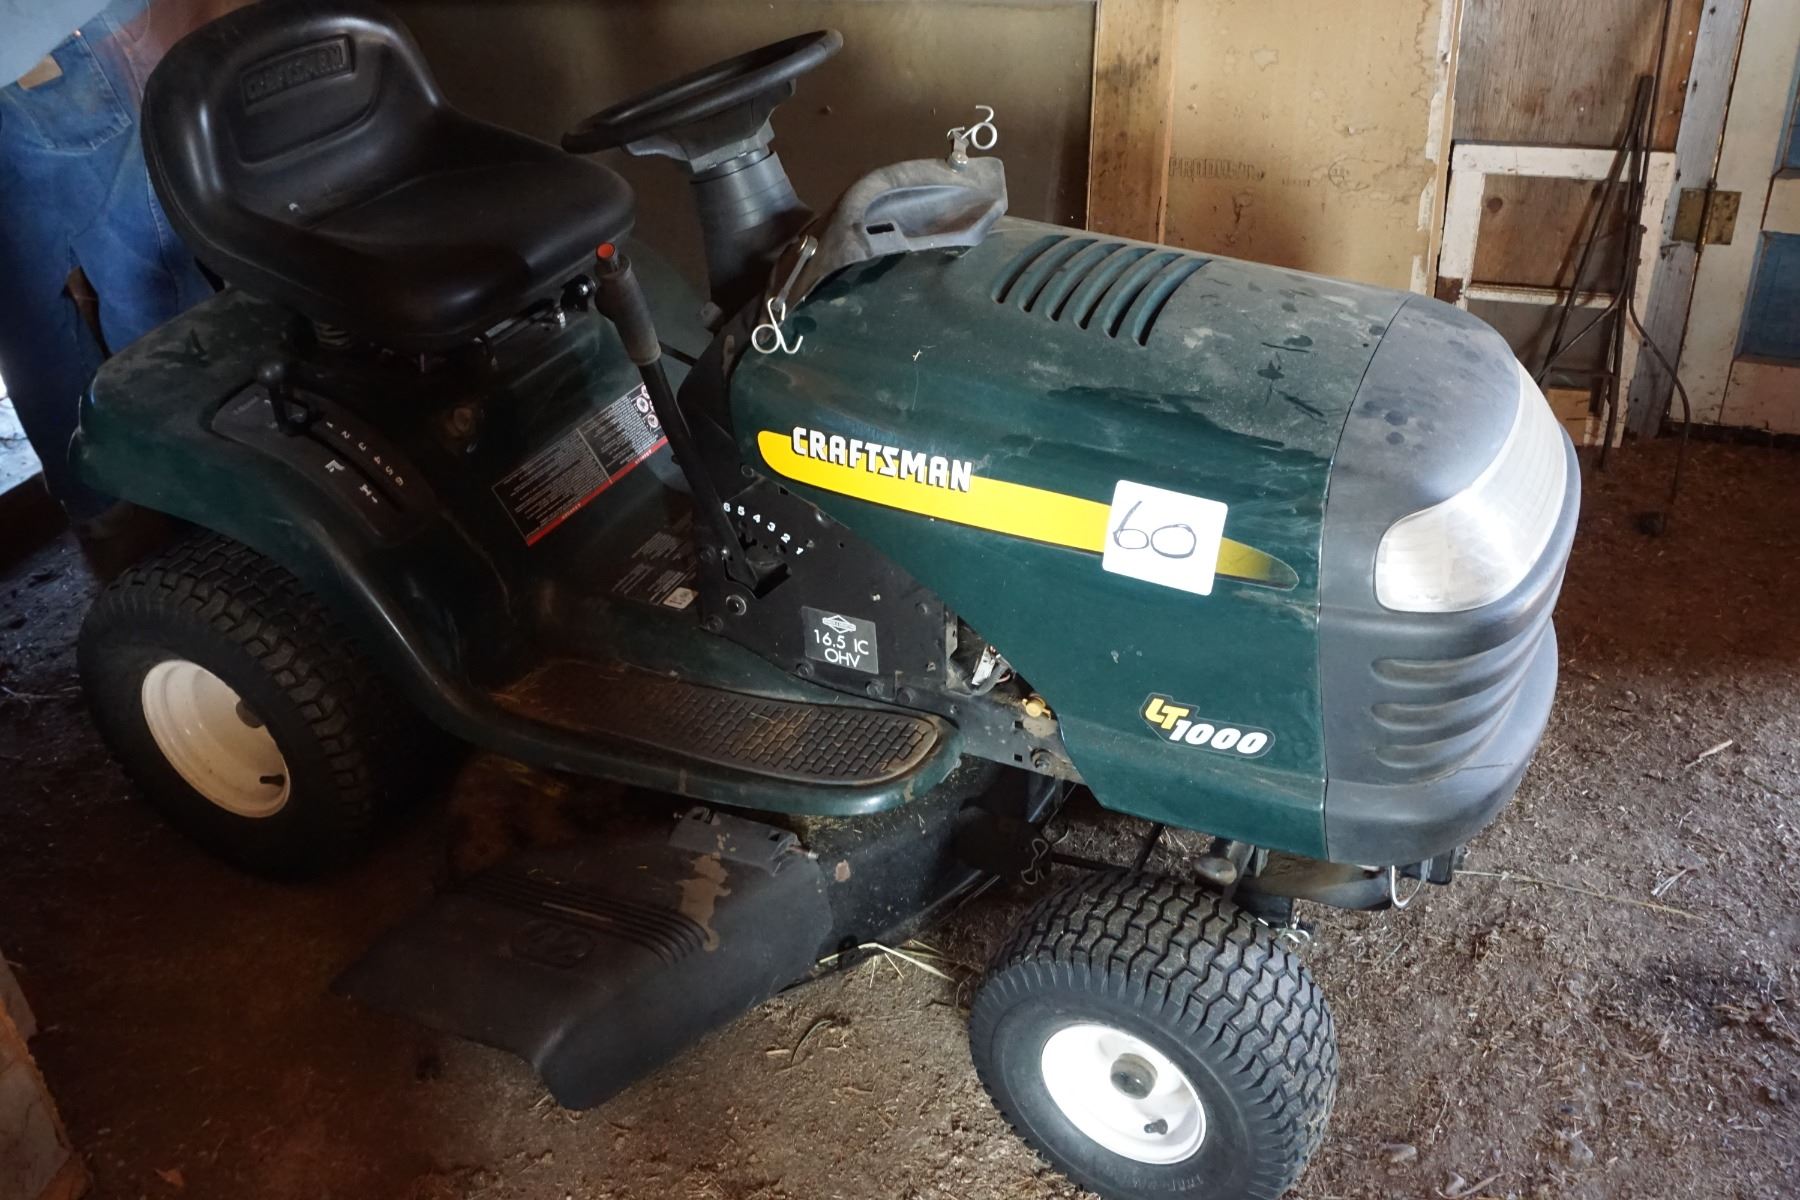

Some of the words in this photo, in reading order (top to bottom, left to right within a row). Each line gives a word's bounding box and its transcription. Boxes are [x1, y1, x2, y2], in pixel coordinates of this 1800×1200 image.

[357, 441, 367, 452] 3
[373, 455, 381, 465] 4
[791, 426, 973, 493] CRAFTSMAN
[723, 502, 731, 512] 6
[737, 505, 745, 516] 5
[752, 513, 761, 523] 4
[767, 521, 776, 532] 3
[780, 532, 791, 544] 2
[795, 546, 804, 555] 1
[1112, 500, 1197, 559] 60
[814, 628, 846, 649] 16.5
[853, 638, 869, 655] IC
[824, 648, 861, 668] OHV
[1145, 698, 1190, 730] LT
[1169, 719, 1268, 754] 1000
